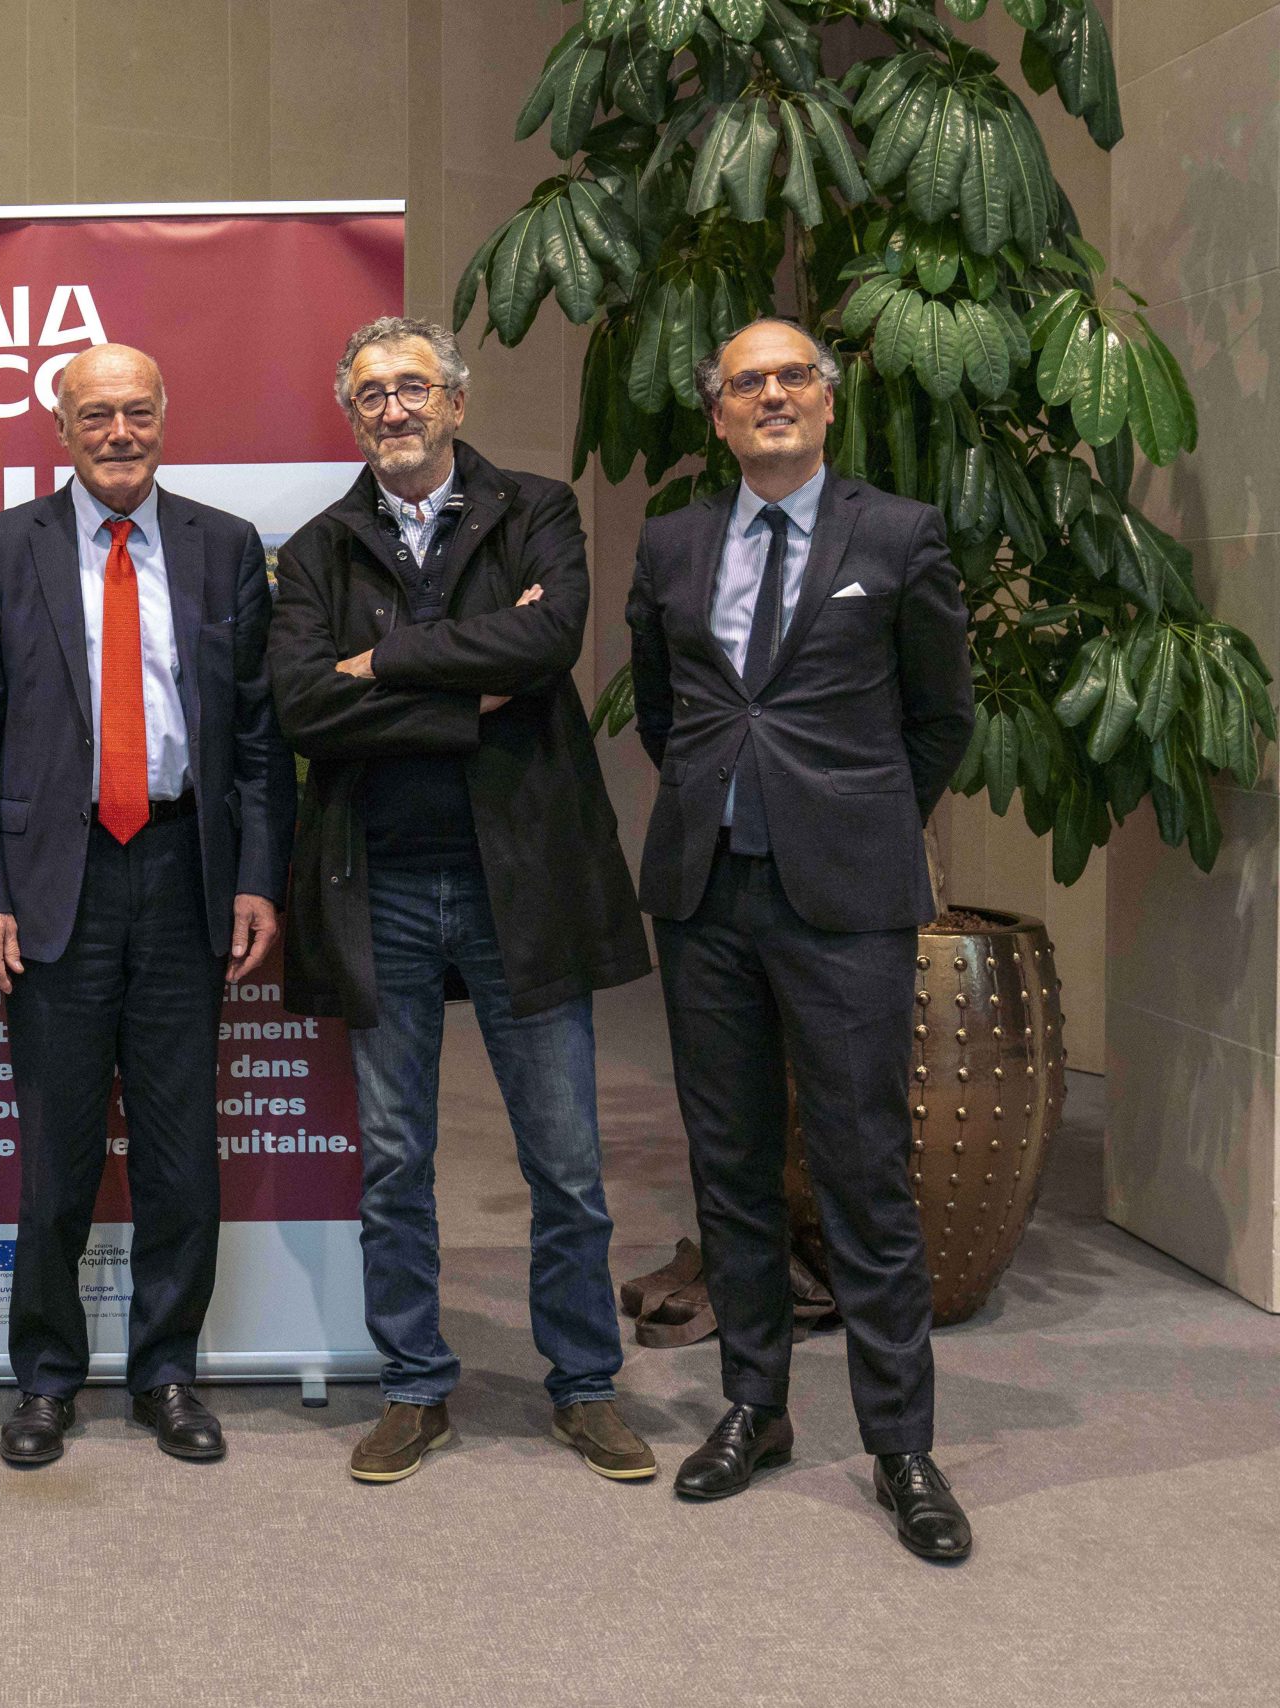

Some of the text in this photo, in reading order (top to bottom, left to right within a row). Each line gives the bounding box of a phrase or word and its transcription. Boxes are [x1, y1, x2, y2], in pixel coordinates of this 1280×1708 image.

[219, 1018, 318, 1040] ement
[231, 1054, 309, 1078] dans
[80, 1256, 129, 1267] Aquitaine
